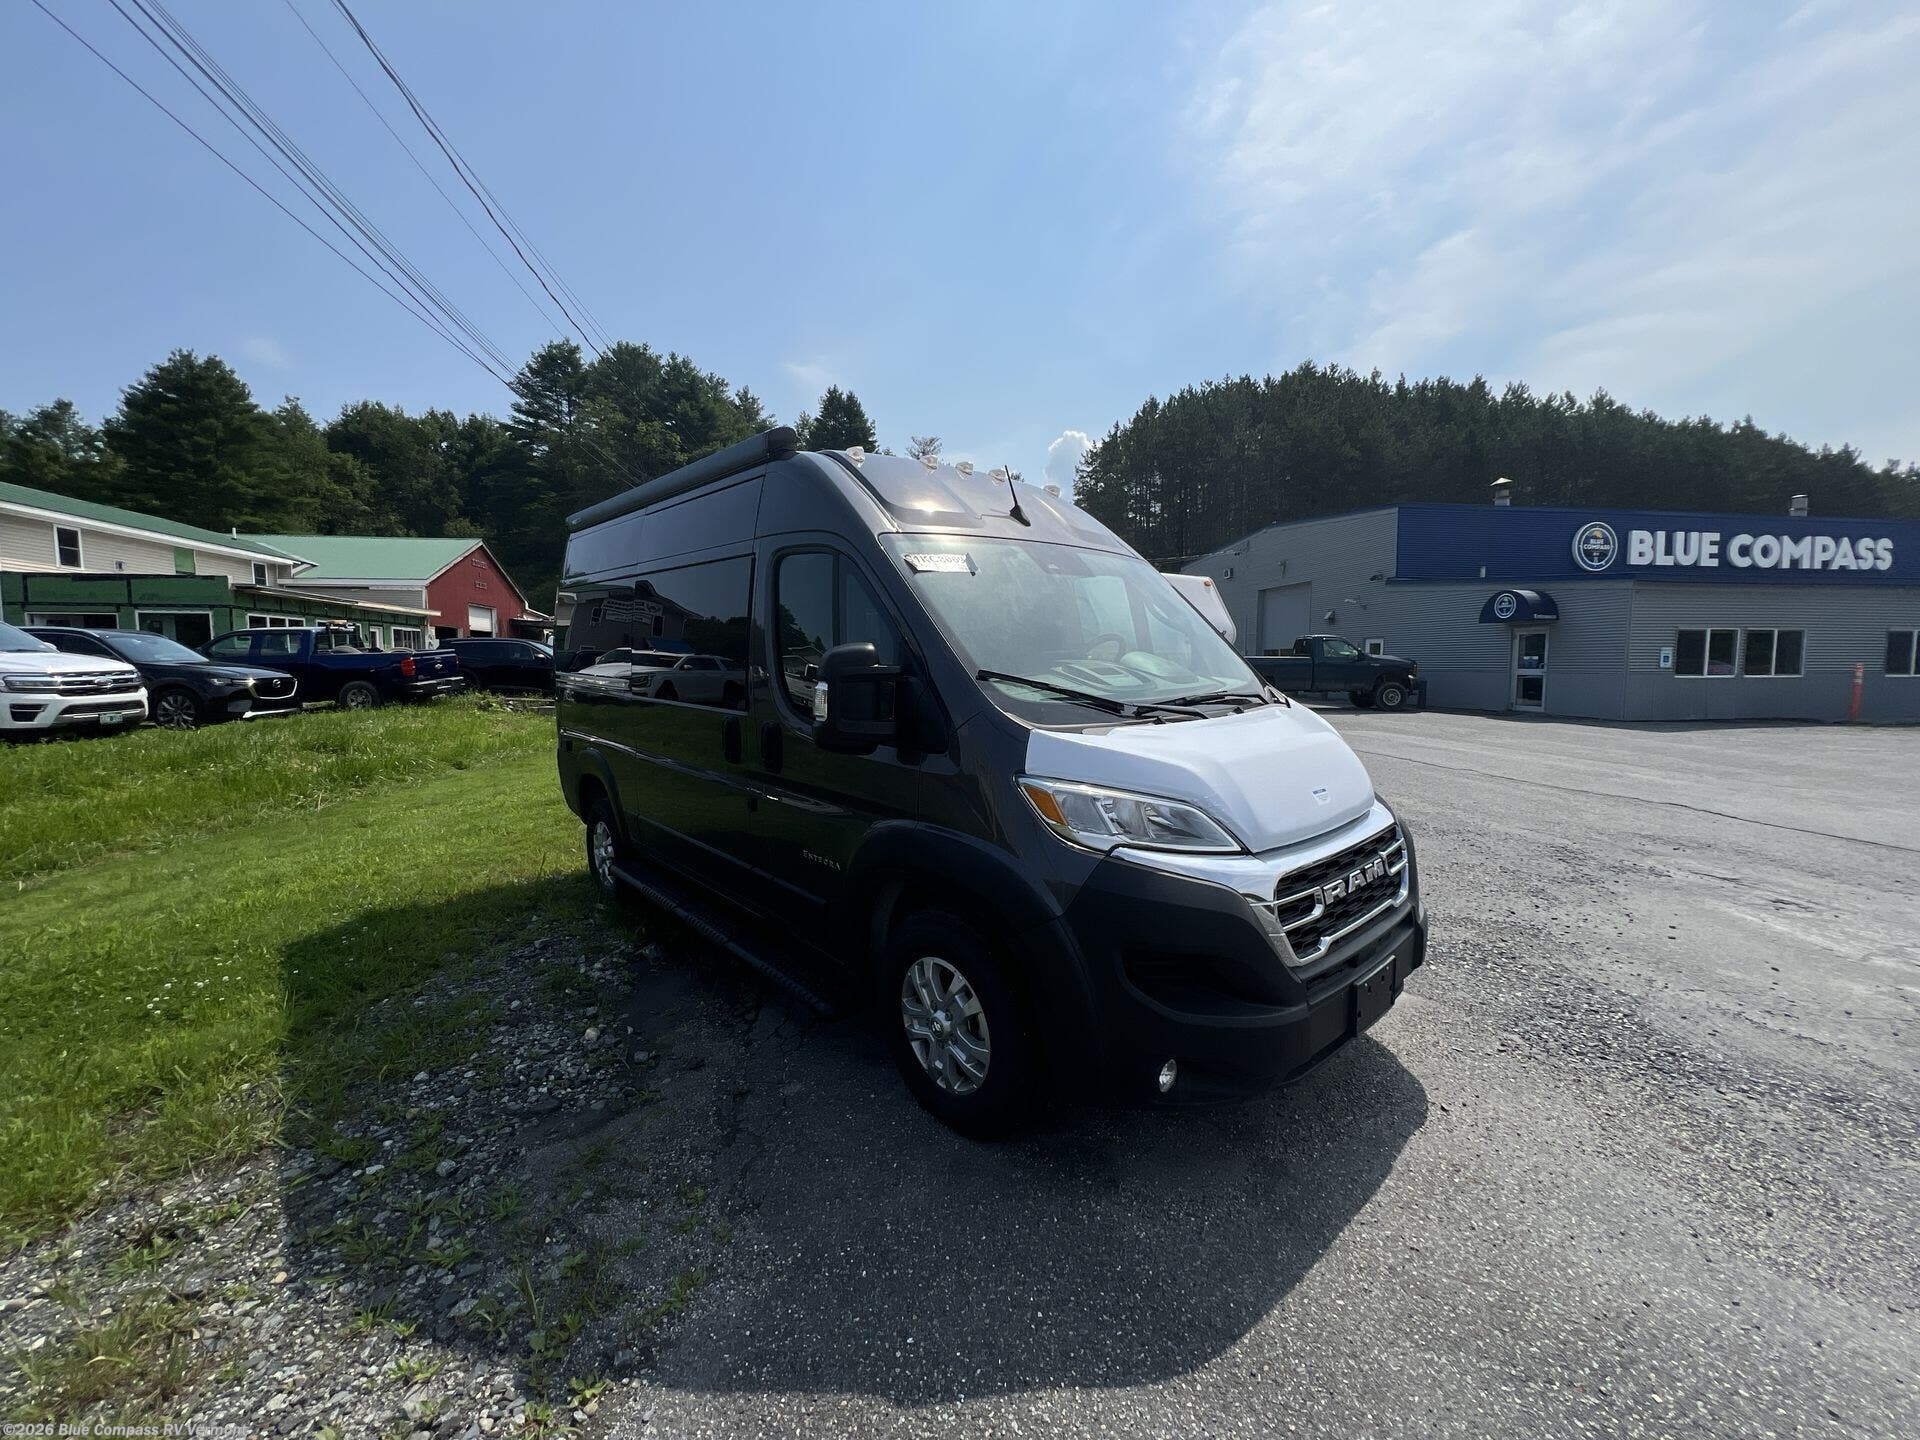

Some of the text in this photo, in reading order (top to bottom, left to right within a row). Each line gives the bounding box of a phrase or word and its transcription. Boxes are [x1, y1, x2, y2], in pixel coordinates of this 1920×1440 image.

[1627, 530, 1894, 571] BLUE COMPASS
[1323, 858, 1386, 905] RAM
